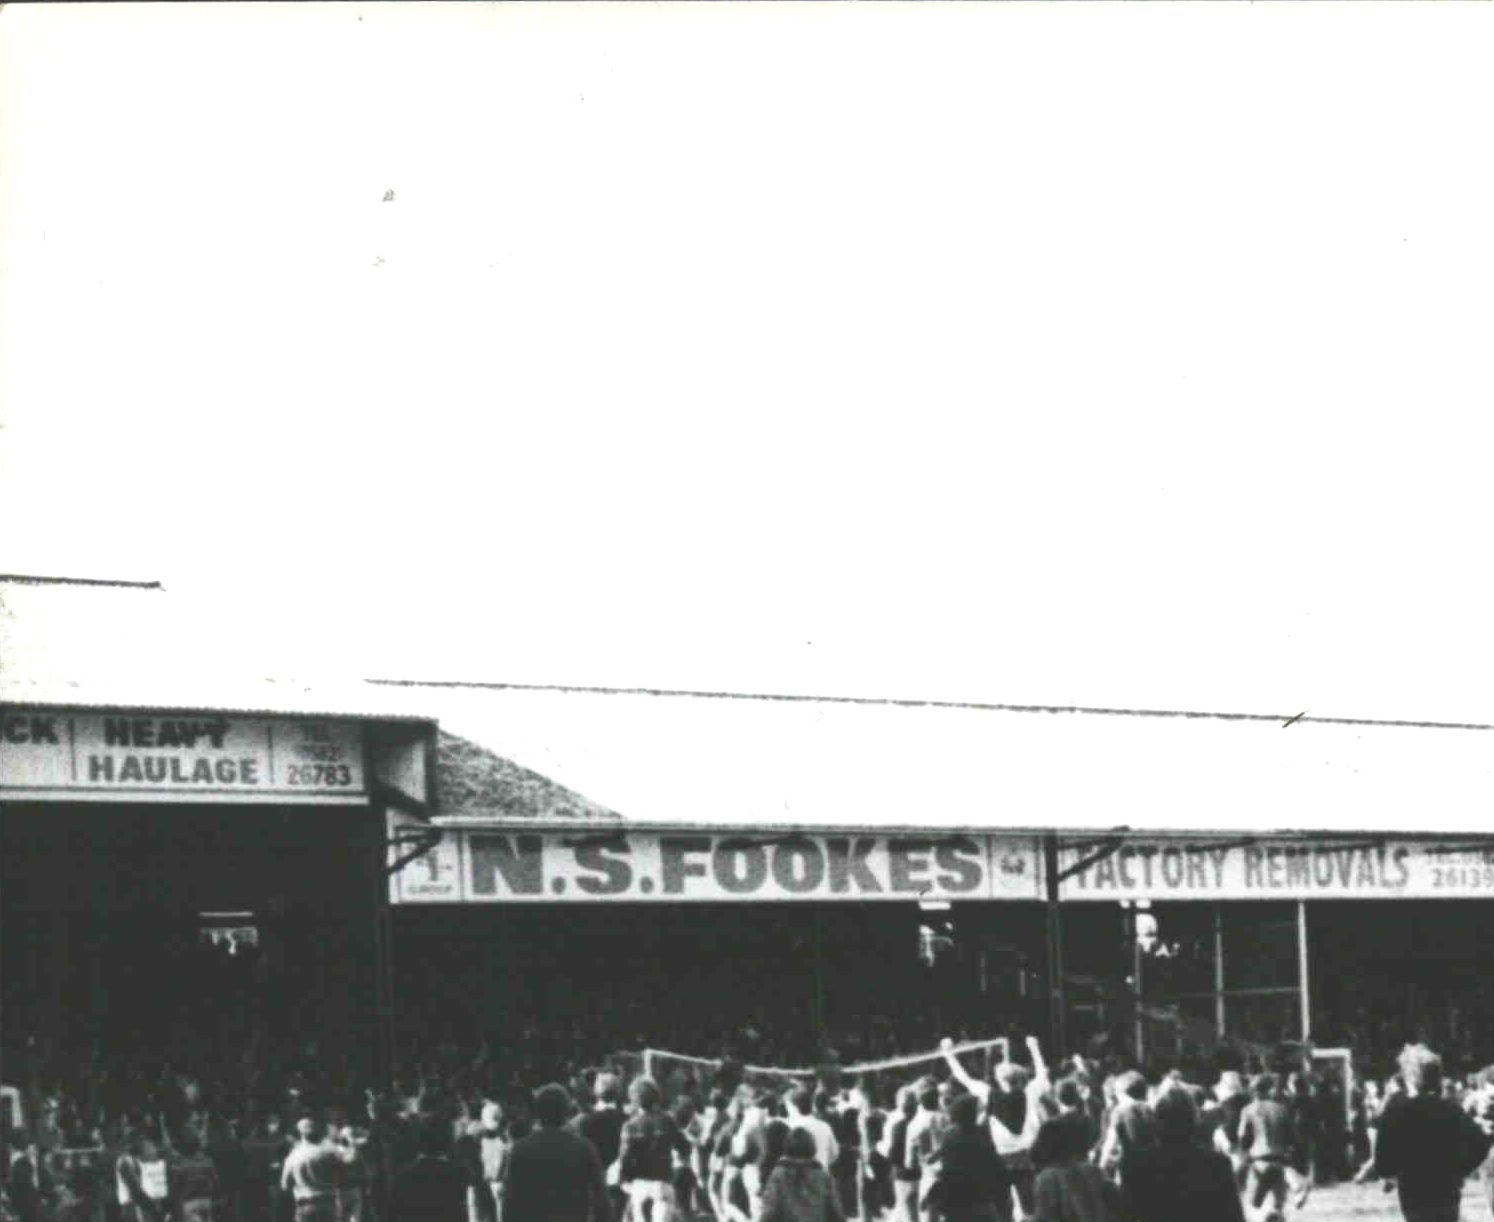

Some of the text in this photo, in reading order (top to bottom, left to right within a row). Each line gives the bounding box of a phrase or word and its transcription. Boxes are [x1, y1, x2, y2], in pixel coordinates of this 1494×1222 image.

[105, 716, 231, 748] HEAVY
[88, 754, 259, 785] HAULAGE
[287, 763, 352, 786] 26783
[1076, 845, 1409, 889] FACTORY REMOVALS
